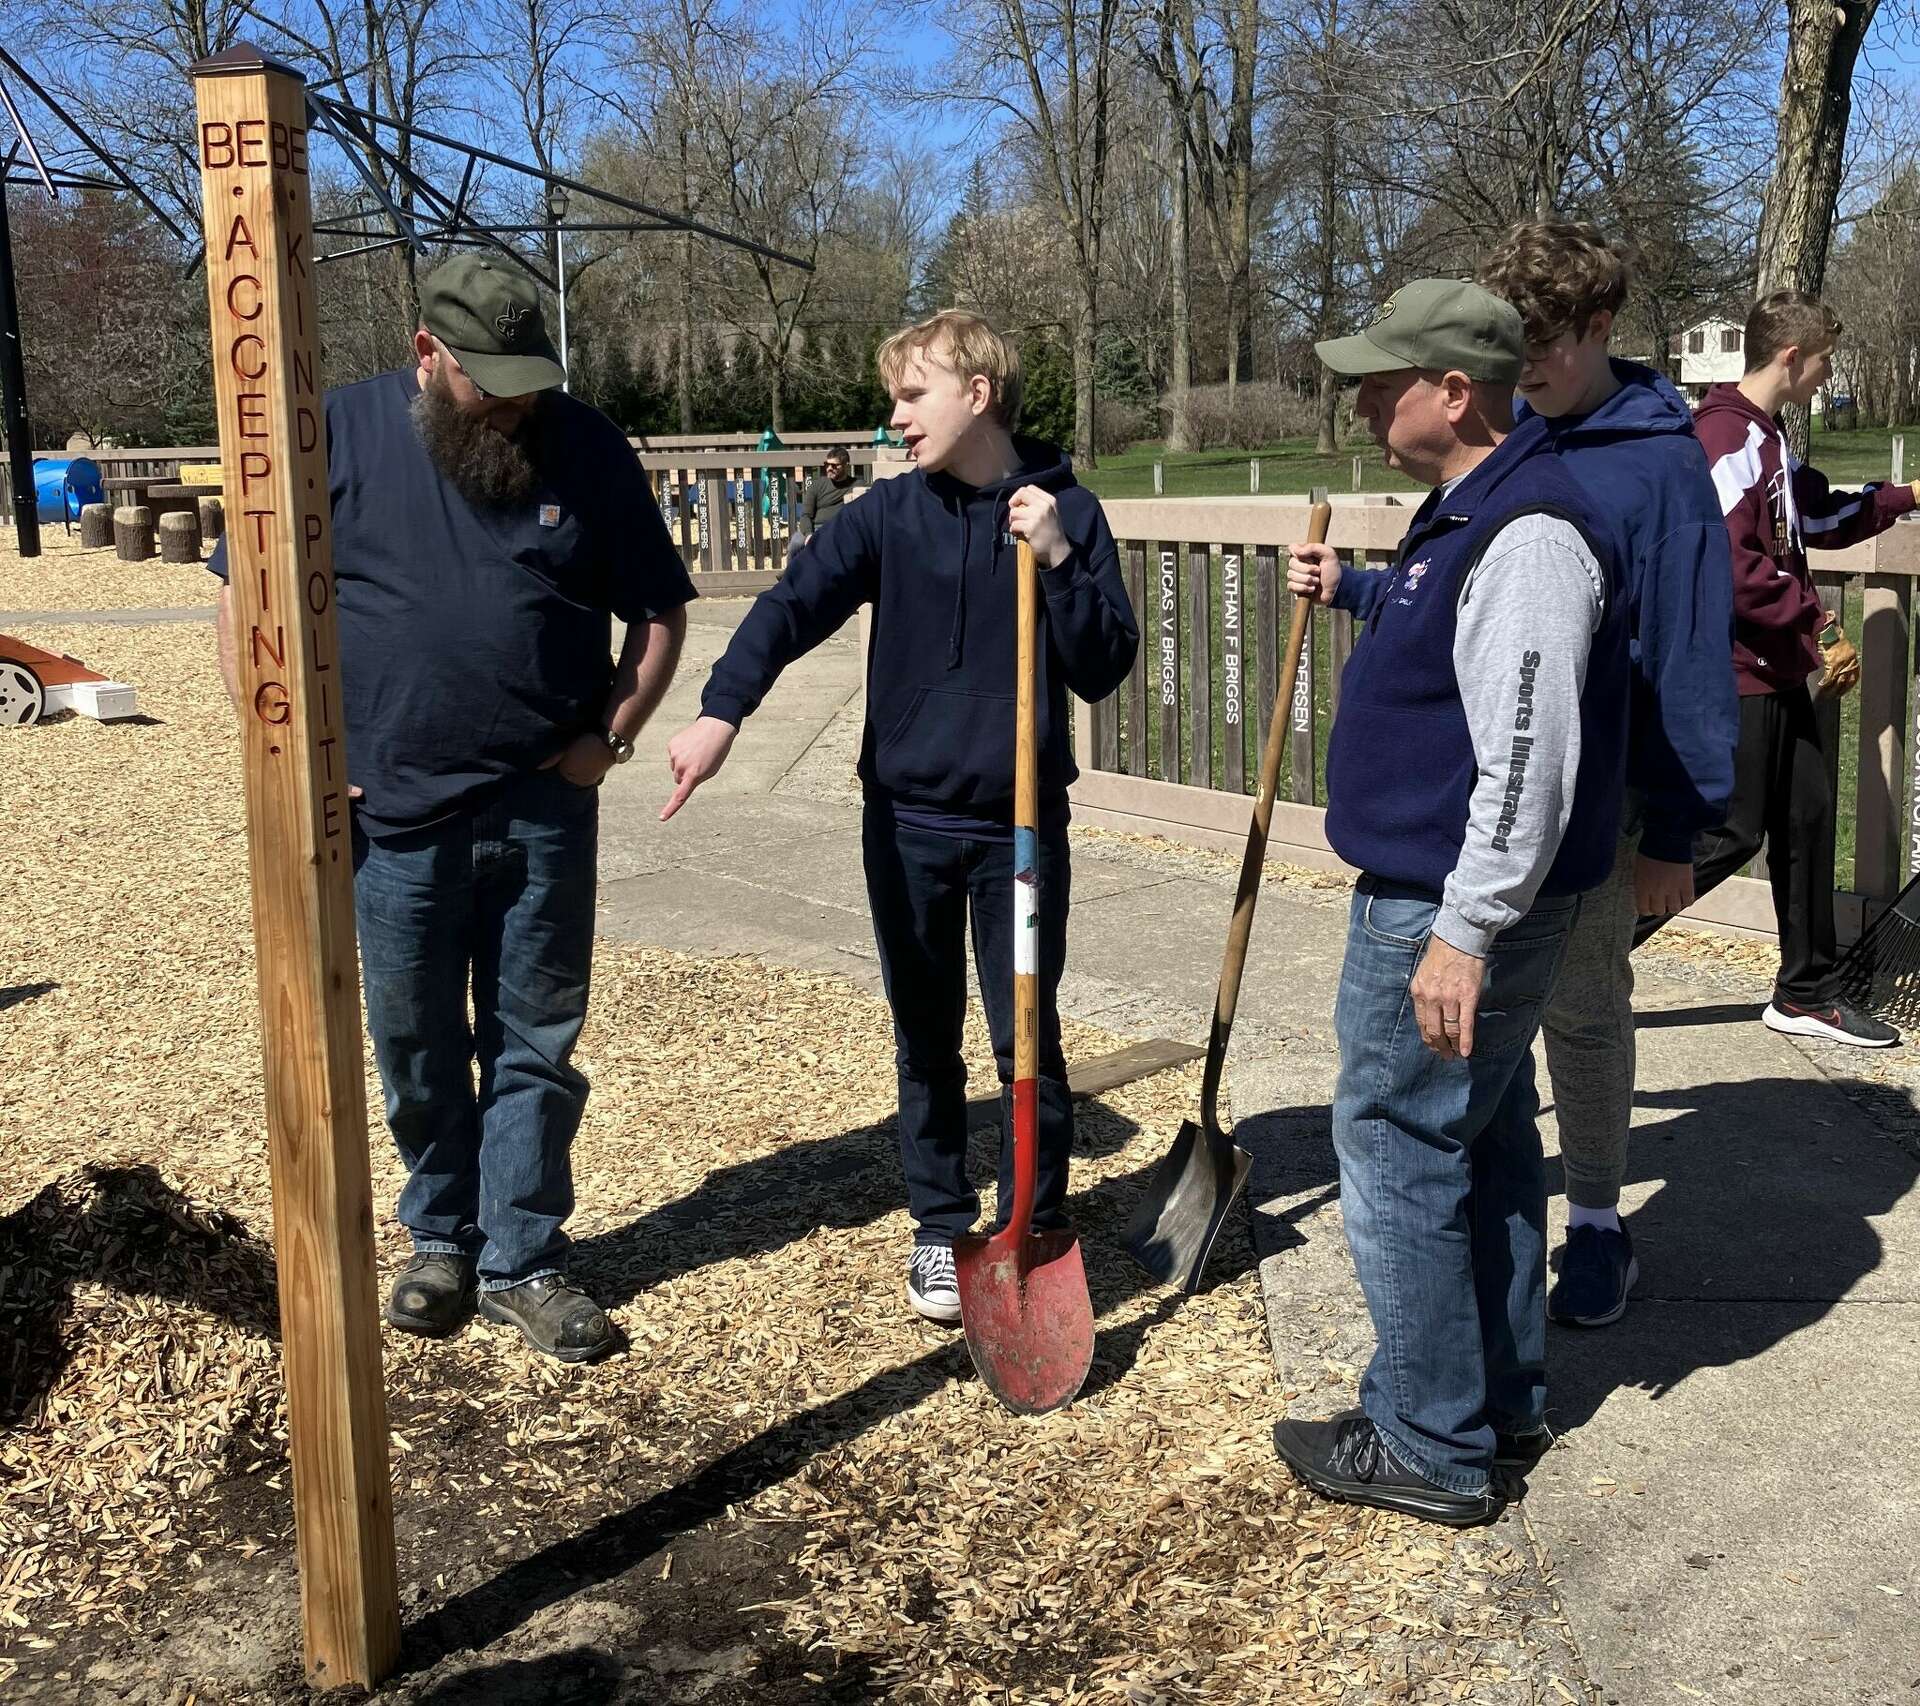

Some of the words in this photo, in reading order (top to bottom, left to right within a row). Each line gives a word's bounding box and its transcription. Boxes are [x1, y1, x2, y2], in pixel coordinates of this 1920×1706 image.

[202, 119, 268, 170] BE
[270, 120, 309, 176] BE
[286, 230, 318, 454] KIND
[225, 214, 291, 726] ACCEPTING
[700, 506, 708, 549] BROTHERS
[737, 505, 746, 549] BROTHERS
[772, 515, 780, 540] HAYES
[1161, 552, 1174, 611] LUCAS
[1225, 554, 1238, 629] NATHAN
[1161, 619, 1174, 631] V
[1225, 635, 1238, 648] F
[303, 513, 341, 839] POLITE
[1162, 637, 1175, 705] BRIGGS
[1225, 654, 1239, 725] BRIGGS
[1295, 635, 1309, 732] DERSEN
[1515, 650, 1541, 731] Sports
[1491, 736, 1535, 854] Illustrated
